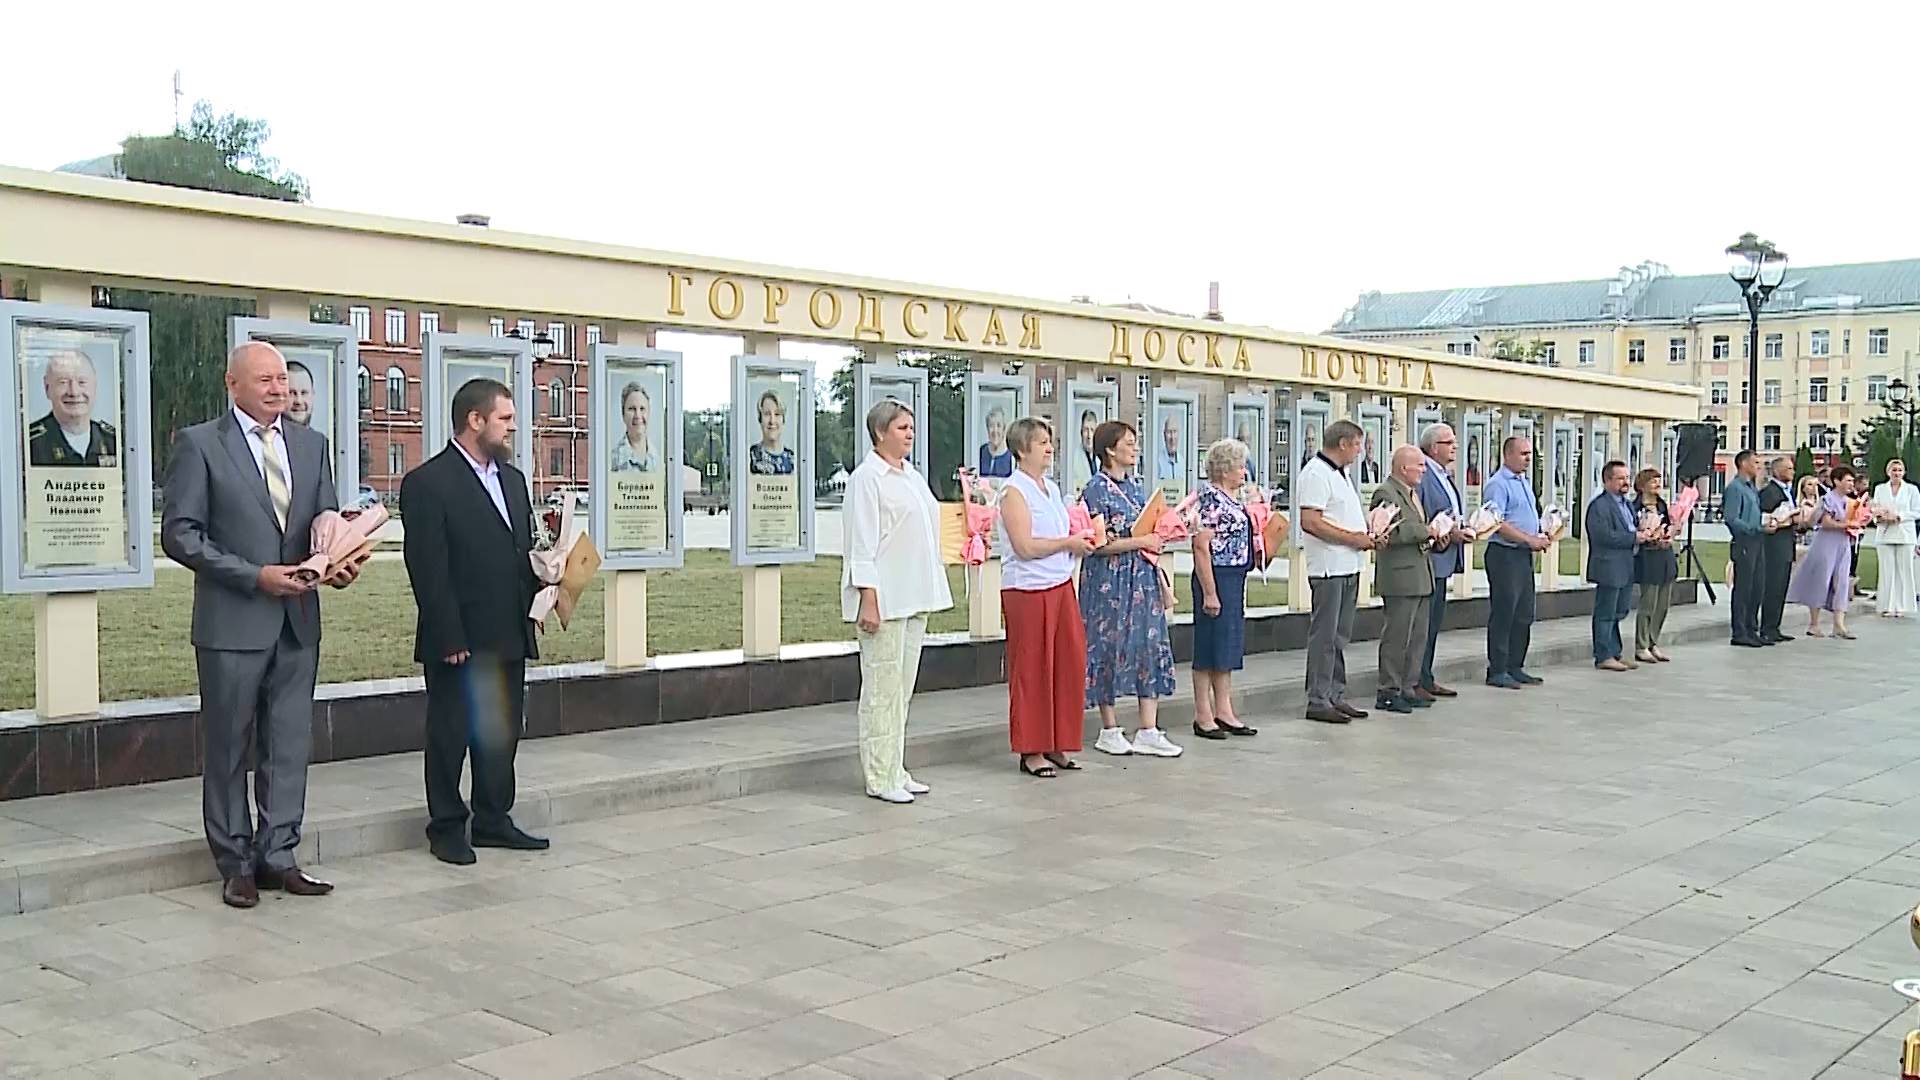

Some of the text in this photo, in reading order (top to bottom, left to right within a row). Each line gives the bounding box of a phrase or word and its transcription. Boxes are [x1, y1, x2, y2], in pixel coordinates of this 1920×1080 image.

[667, 271, 1435, 390] ГОРОДСКАЯ ДОСКА ПОЧЕТА
[44, 479, 105, 491] Андреев
[46, 493, 104, 503] Владимир
[50, 506, 101, 515] Иванович
